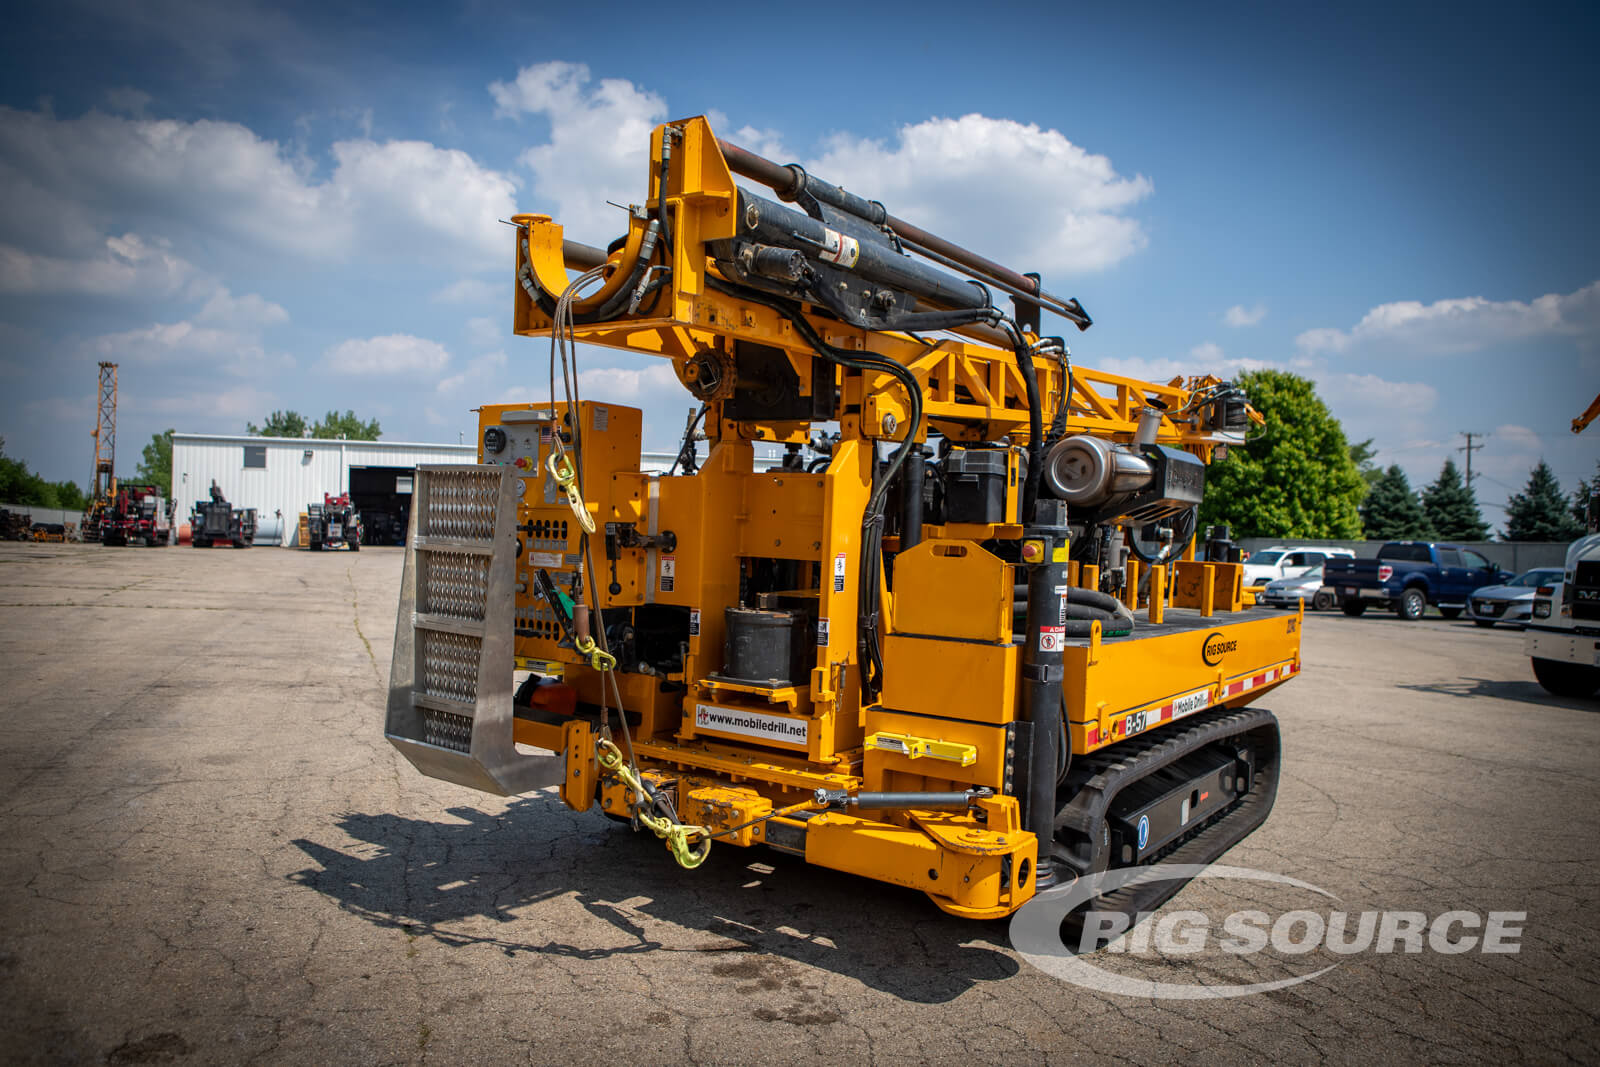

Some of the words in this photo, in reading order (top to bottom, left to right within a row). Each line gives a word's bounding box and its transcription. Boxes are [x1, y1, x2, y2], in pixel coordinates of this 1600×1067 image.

[1207, 643, 1217, 656] RIG
[1217, 640, 1237, 655] SOURCE
[1178, 697, 1193, 713] Mobile
[709, 713, 806, 737] www.mobiledrill.net
[1126, 710, 1147, 736] B-57
